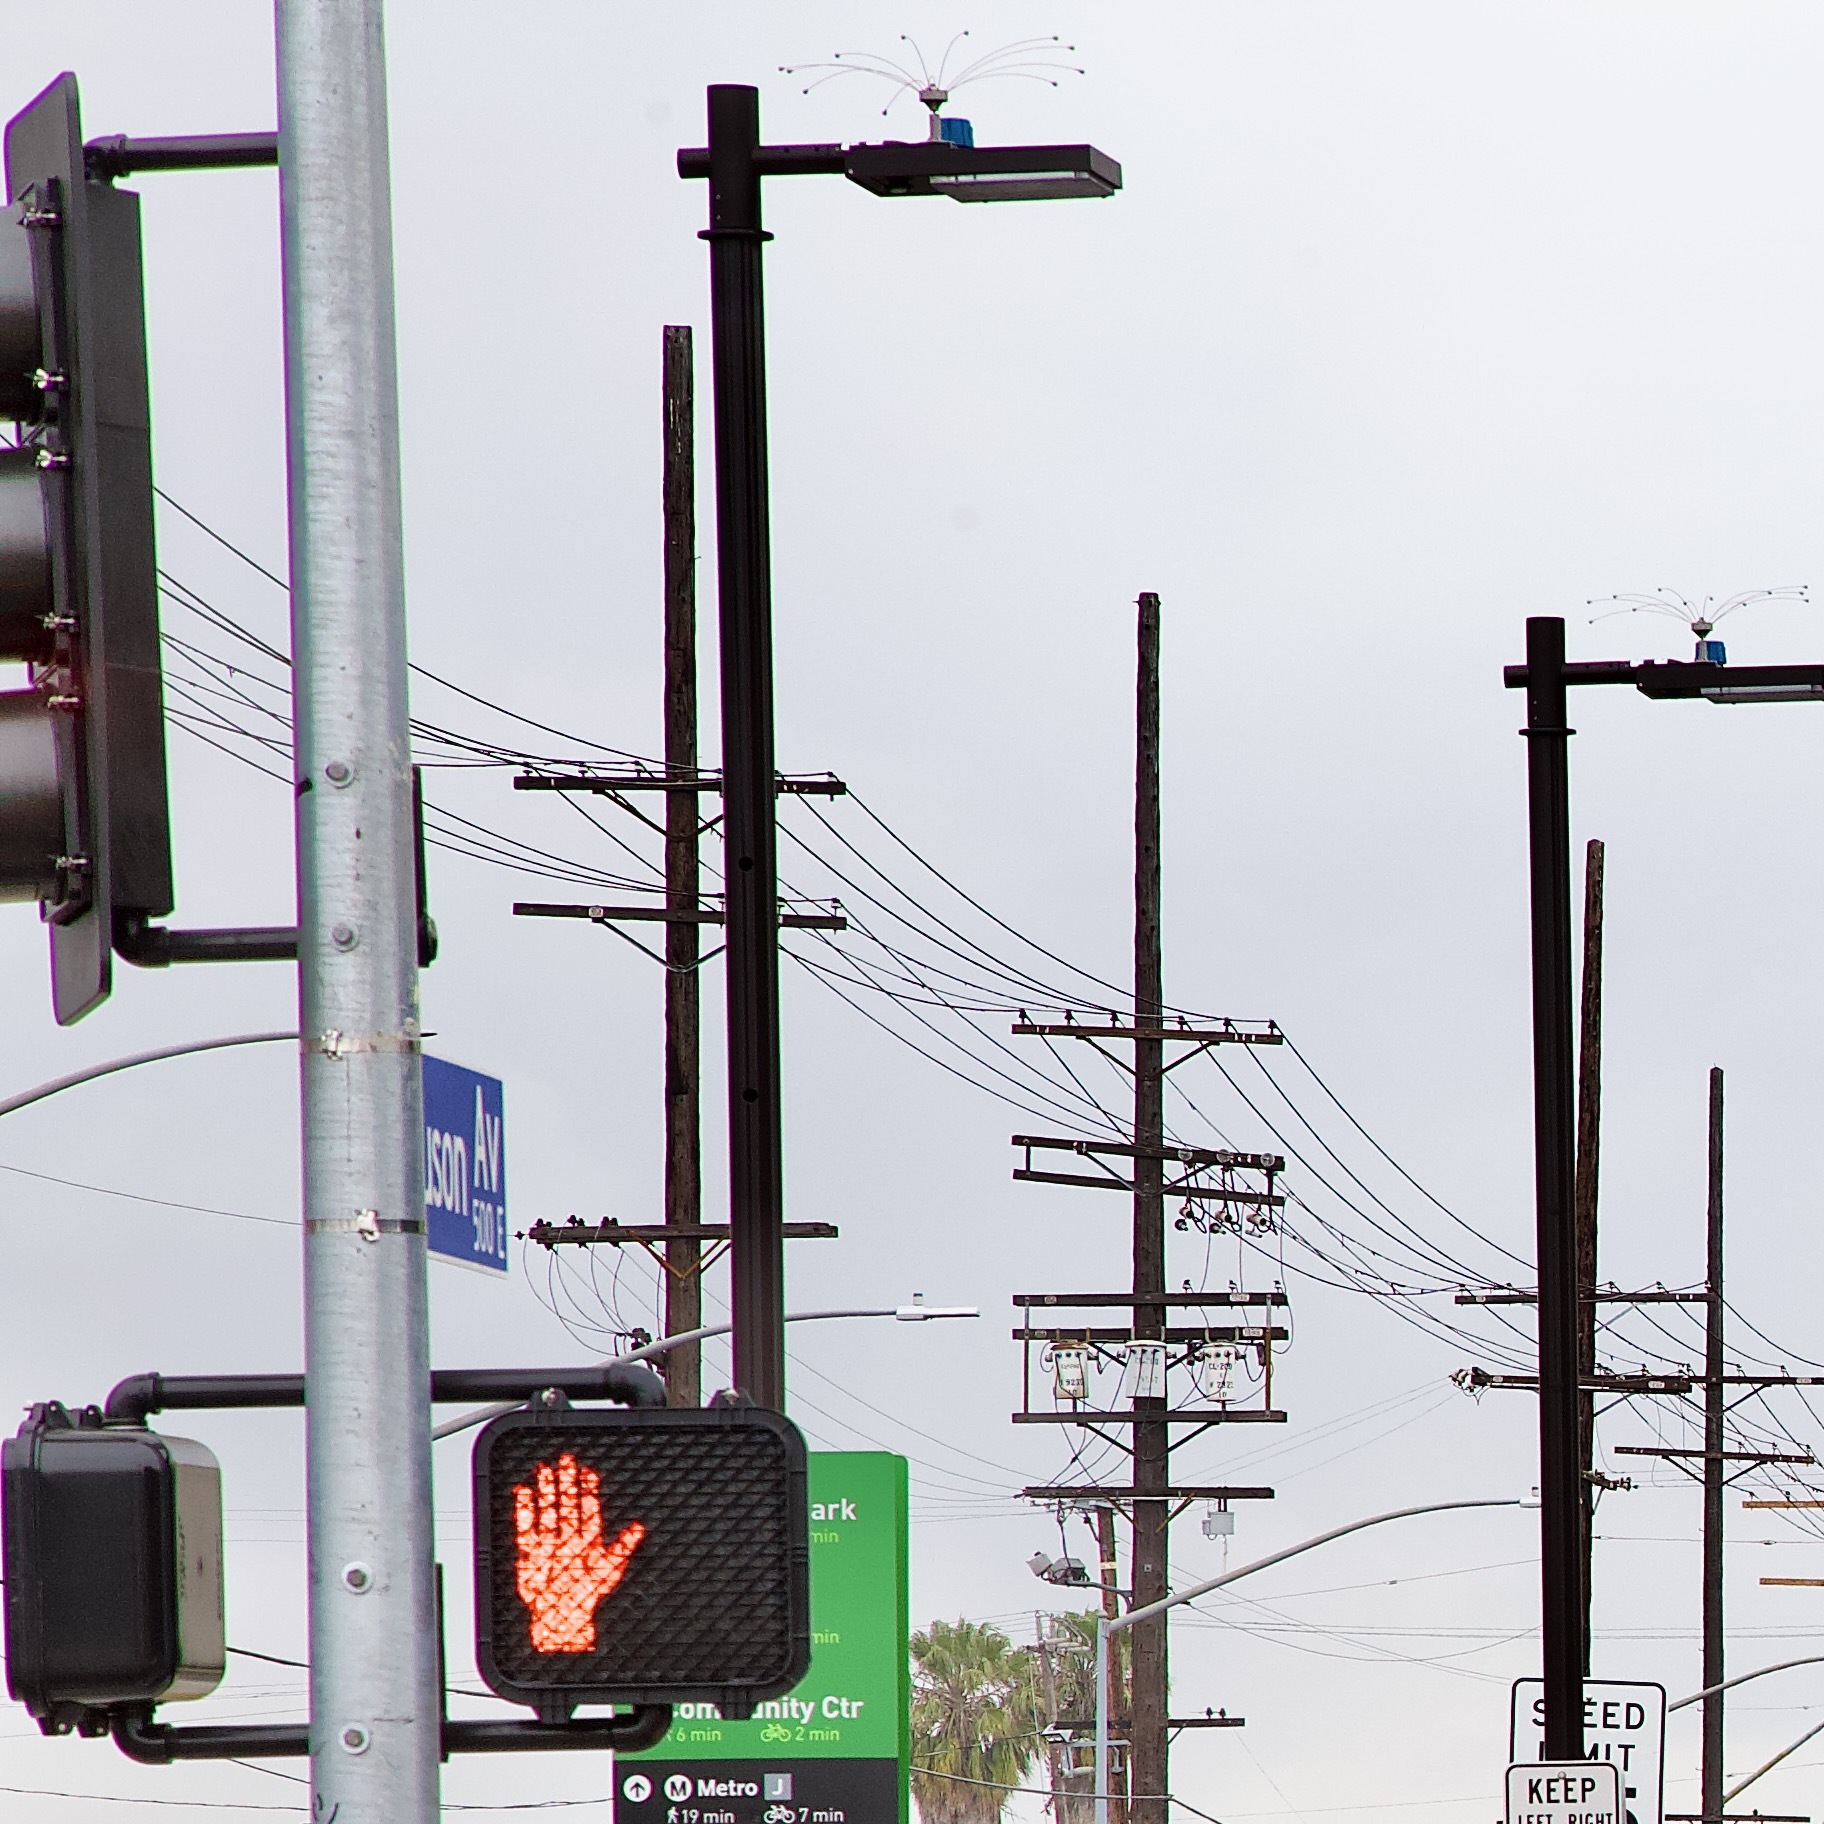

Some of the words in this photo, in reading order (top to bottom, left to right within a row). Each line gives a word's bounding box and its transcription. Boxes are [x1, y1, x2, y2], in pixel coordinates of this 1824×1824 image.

[473, 1084, 500, 1193] Av
[472, 1199, 494, 1255] 500
[496, 1205, 505, 1259] E
[811, 1498, 857, 1520] ark
[822, 1696, 864, 1719] Ctr
[1532, 1698, 1645, 1729] SEED
[676, 1728, 686, 1742] 6
[690, 1727, 721, 1742] min
[795, 1727, 804, 1741] 2
[809, 1726, 840, 1741] min
[697, 1779, 759, 1797] Metro
[1528, 1778, 1596, 1804] KEEP
[681, 1809, 699, 1824] 19
[703, 1809, 735, 1824] min
[798, 1807, 808, 1822] 7
[812, 1808, 844, 1823] min
